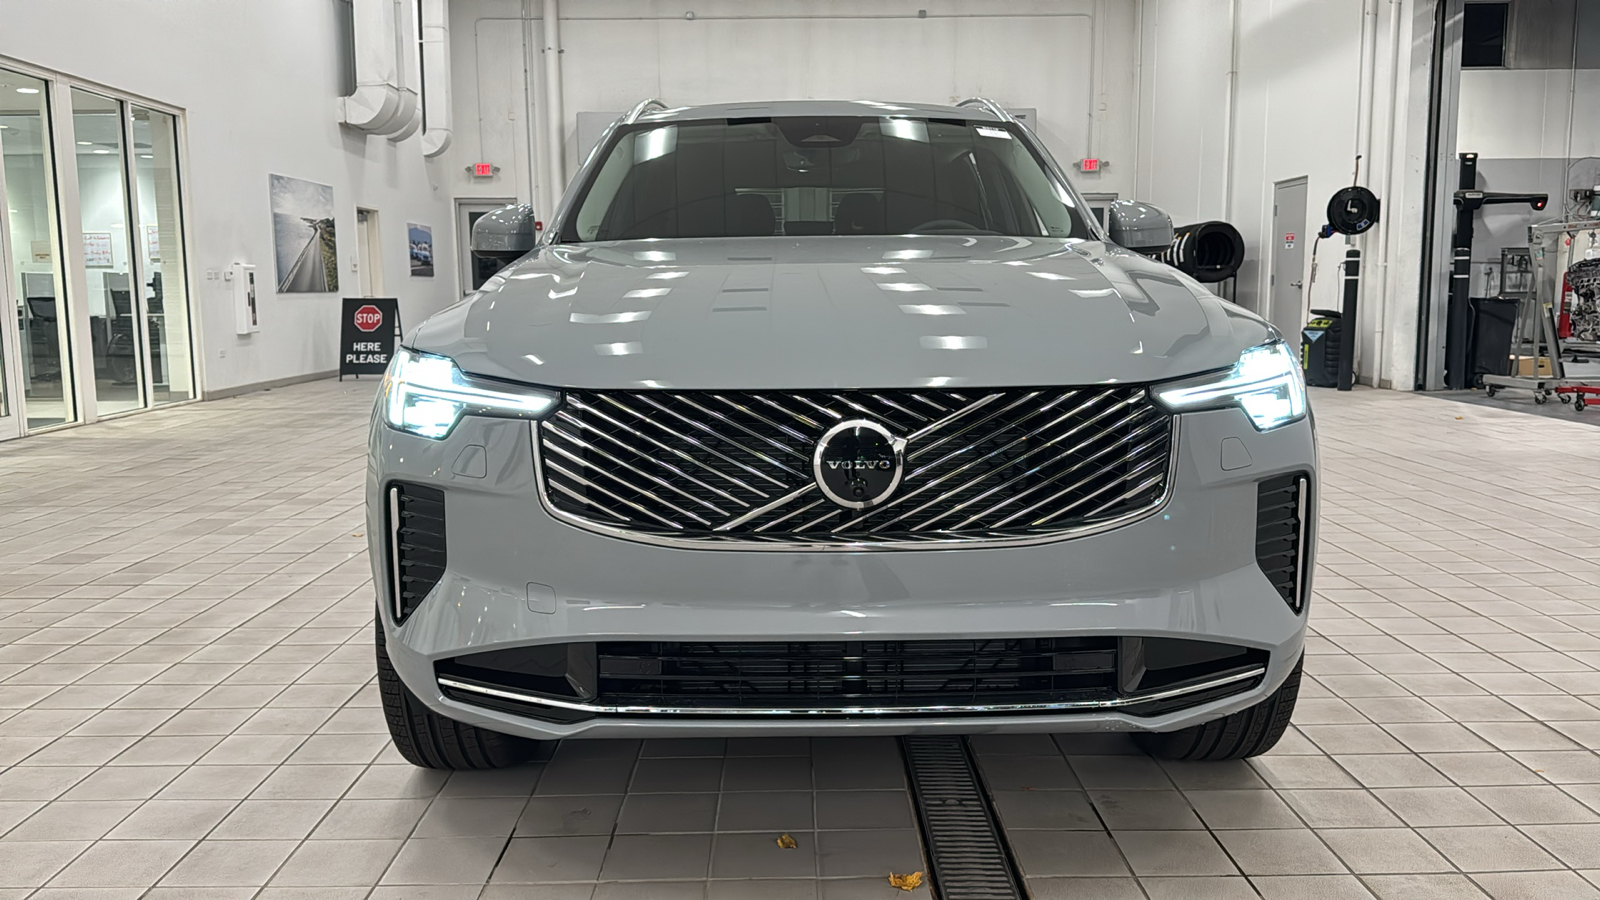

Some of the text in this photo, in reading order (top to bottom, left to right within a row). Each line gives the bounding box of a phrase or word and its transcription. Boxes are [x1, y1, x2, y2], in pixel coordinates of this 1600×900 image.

[1084, 159, 1098, 170] EXIT
[356, 313, 380, 324] STOP
[353, 342, 381, 351] HERE
[345, 354, 387, 364] PLEASE
[826, 460, 890, 470] VOLVO
